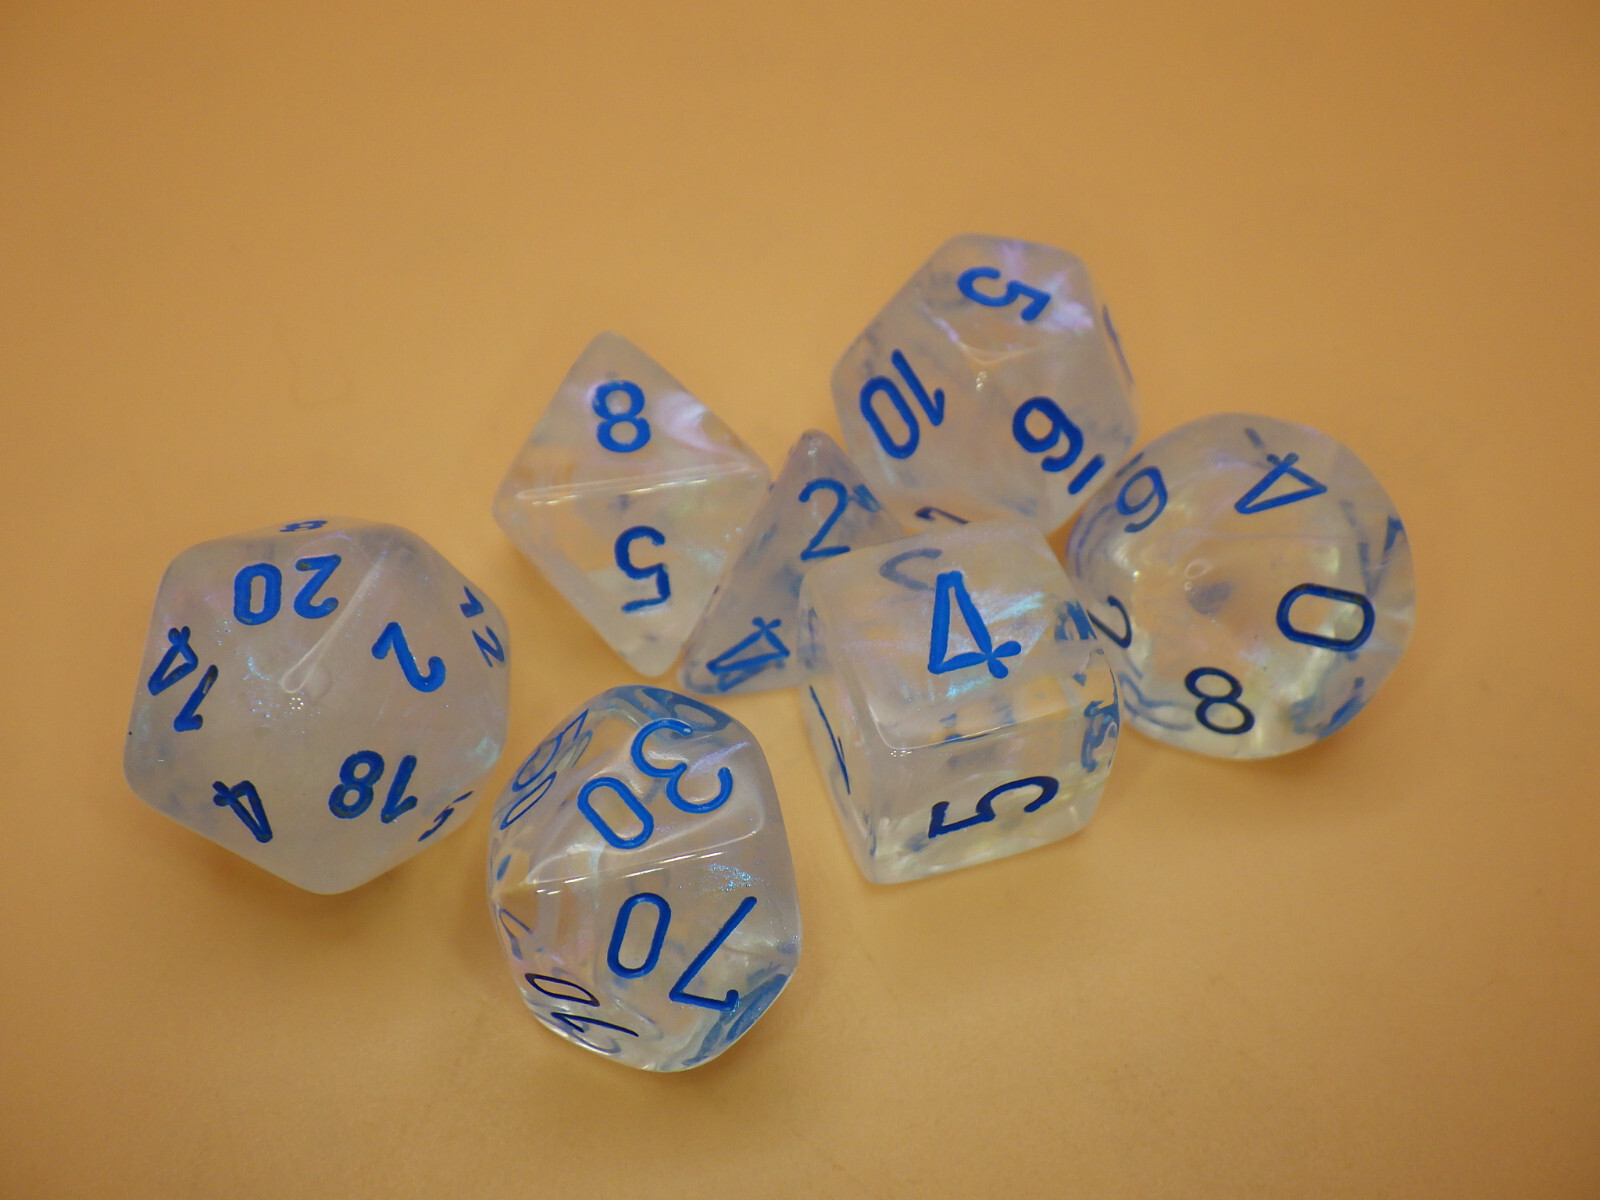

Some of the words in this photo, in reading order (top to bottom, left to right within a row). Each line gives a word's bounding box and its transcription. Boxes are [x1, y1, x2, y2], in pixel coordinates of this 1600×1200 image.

[956, 266, 1053, 323] 5
[591, 379, 653, 454] 8
[859, 349, 947, 461] 10
[798, 477, 853, 562] 2
[1234, 452, 1328, 514] 4
[232, 553, 343, 626] 20
[613, 524, 672, 615] 5
[705, 616, 792, 677] 4
[927, 569, 1022, 680] 4
[1275, 582, 1376, 653] 0
[147, 625, 219, 733] 14
[370, 621, 448, 693] 2
[1184, 666, 1256, 735] 8
[212, 779, 274, 844] 4
[327, 750, 419, 825] 18
[576, 717, 734, 850] 30
[928, 775, 1060, 840] 5
[606, 892, 758, 1011] 70
[524, 972, 640, 1038] 10
